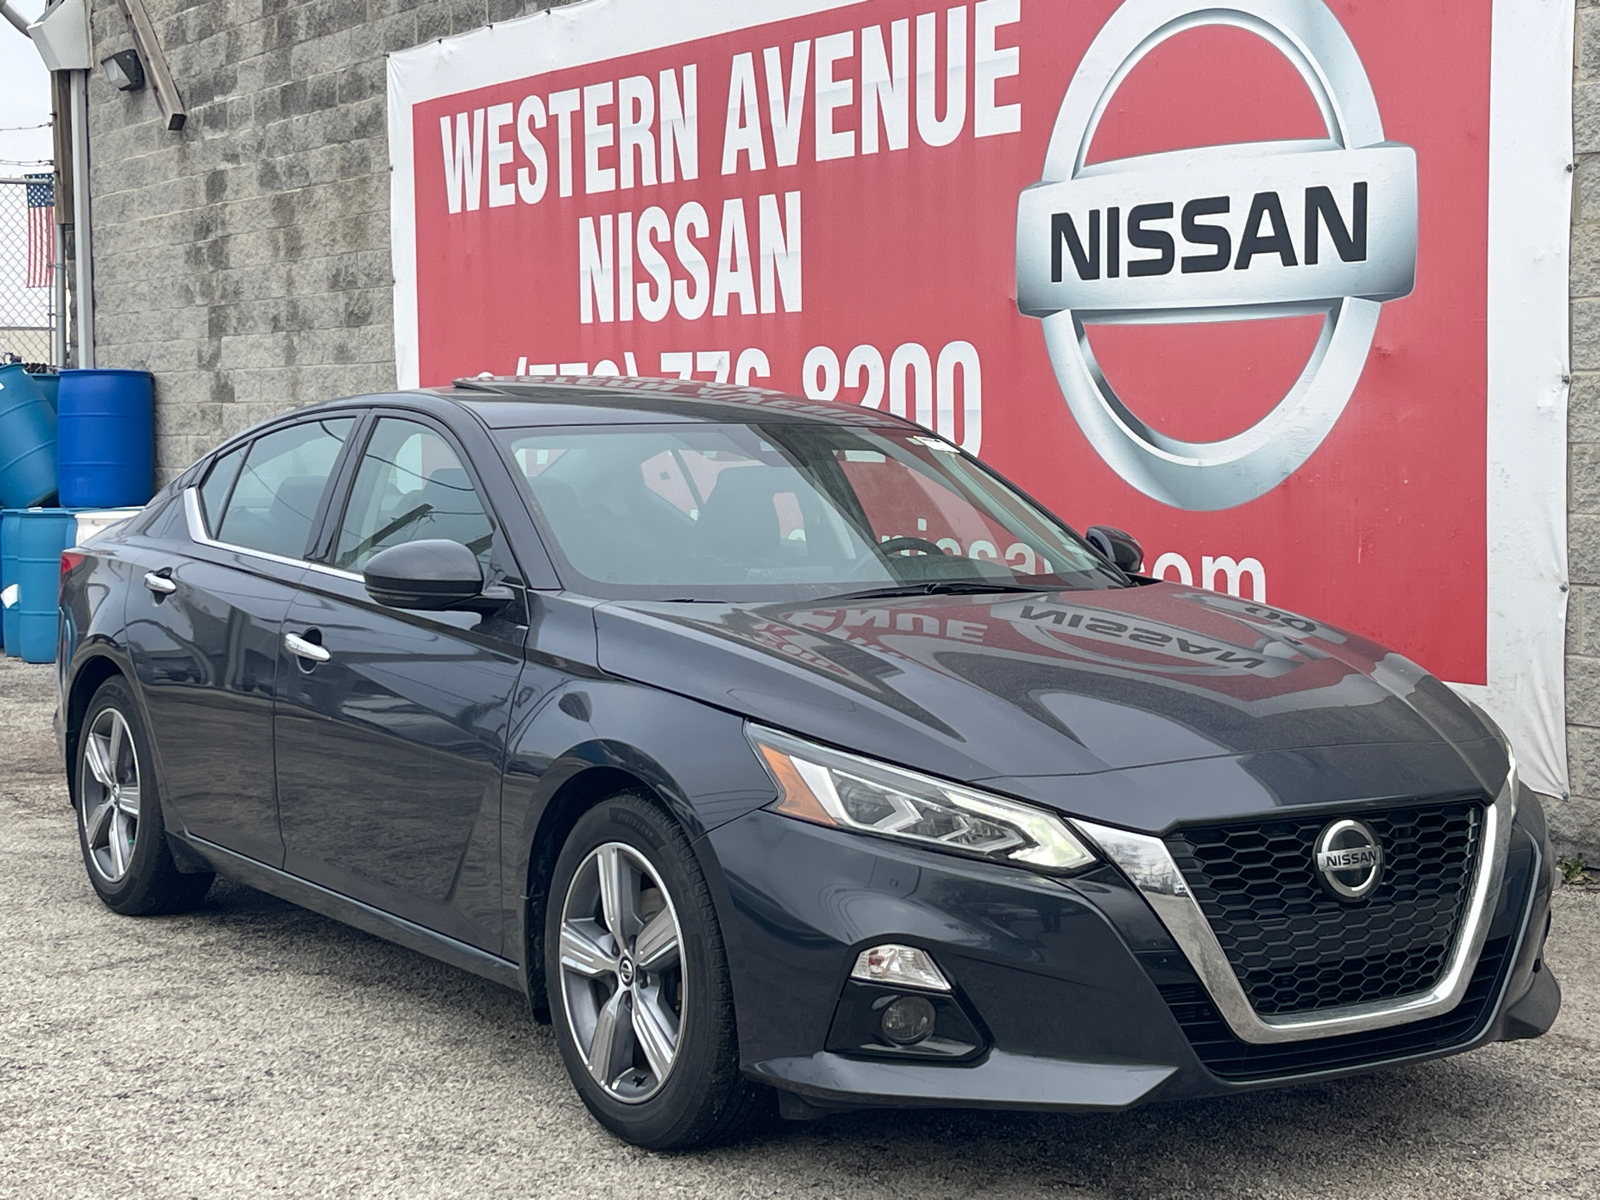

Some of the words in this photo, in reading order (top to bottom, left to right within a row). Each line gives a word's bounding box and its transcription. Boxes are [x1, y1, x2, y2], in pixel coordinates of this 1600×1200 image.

[439, 64, 698, 214] WESTERN
[721, 0, 1022, 177] AVENUE
[578, 191, 802, 324] NISSAN
[1051, 181, 1368, 283] NISSAN
[1326, 850, 1377, 867] NISSAN
